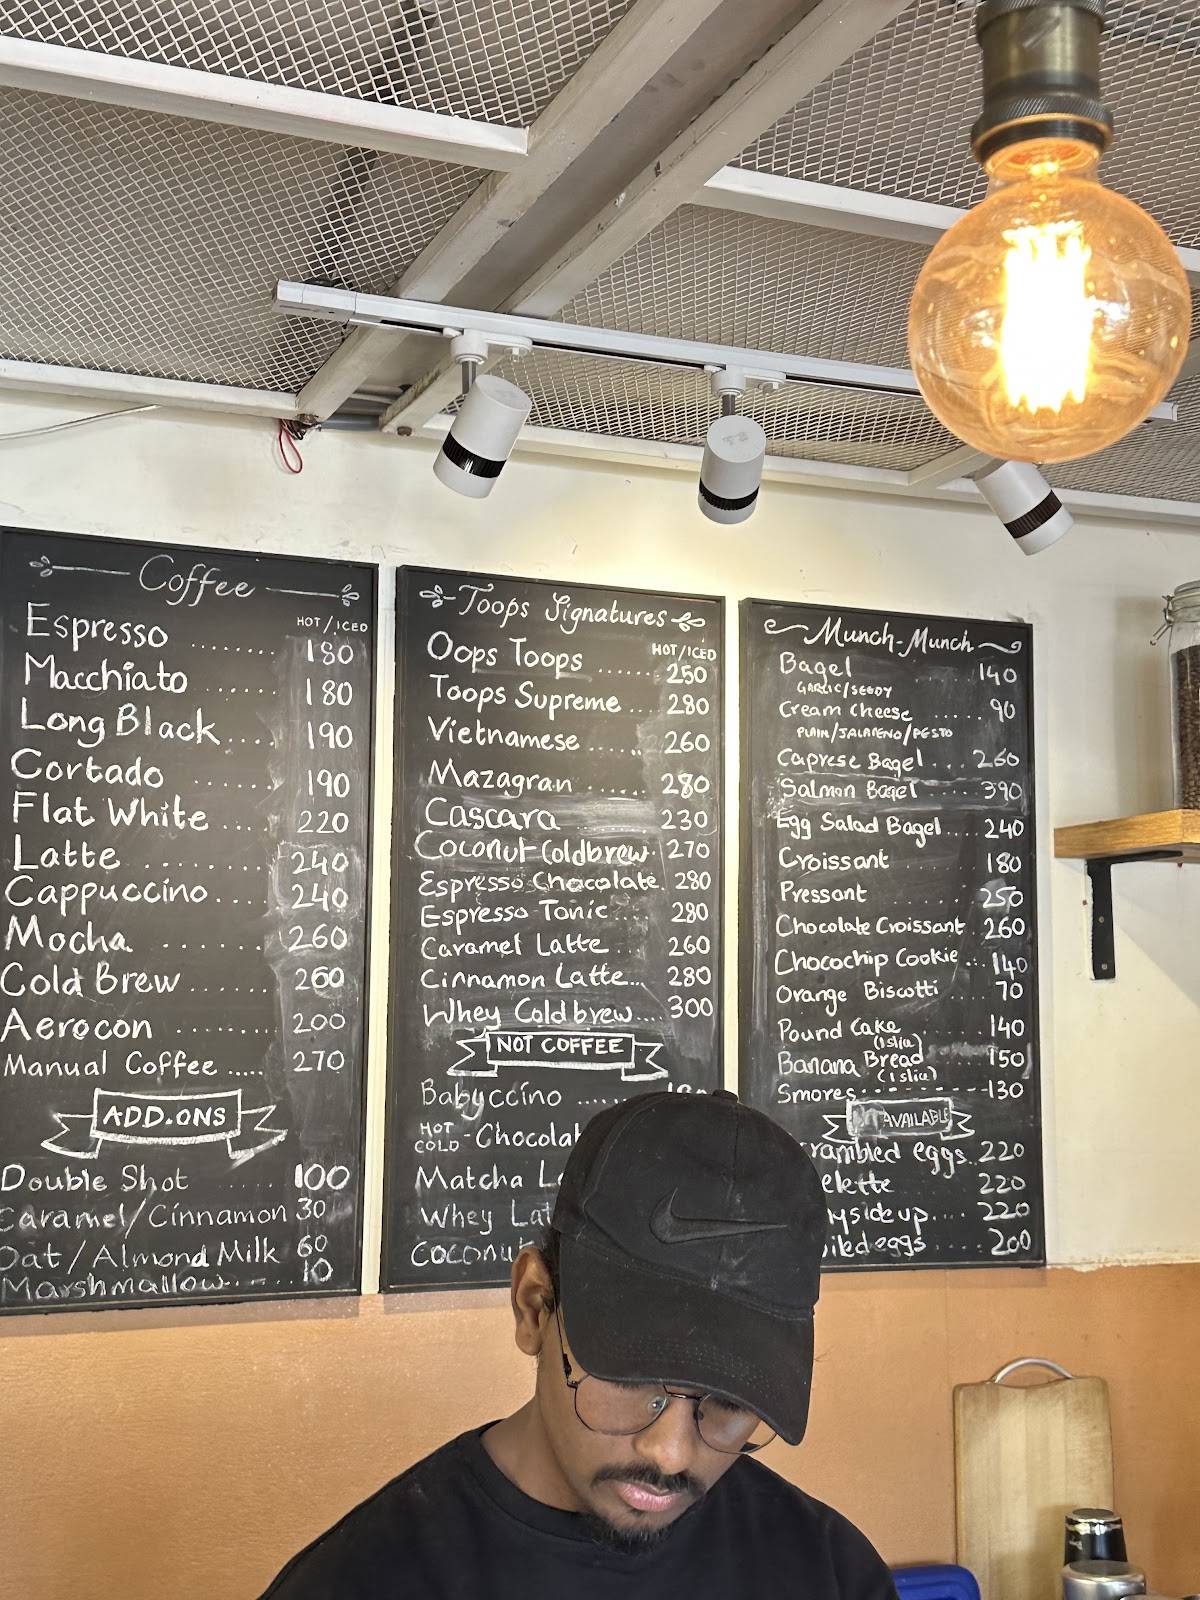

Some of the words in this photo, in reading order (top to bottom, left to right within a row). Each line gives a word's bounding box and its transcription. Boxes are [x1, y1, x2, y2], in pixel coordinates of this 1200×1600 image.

[139, 554, 256, 606] Coffee
[459, 584, 530, 628] Toops
[545, 592, 668, 634] Signatures
[27, 601, 169, 651] Espresso
[307, 639, 354, 665] 180
[427, 631, 498, 673] Oops
[509, 638, 583, 680] Toops
[666, 663, 707, 685] 250
[780, 652, 851, 687] Bagel
[979, 663, 1017, 685] 140
[24, 651, 188, 693] Macchiato
[306, 678, 353, 705] 180
[430, 674, 506, 712] Toops
[514, 681, 622, 720] Supreme
[666, 693, 709, 715] 280
[779, 701, 842, 718] Cream
[990, 699, 1016, 722] 90
[21, 697, 105, 748] Long
[116, 703, 221, 745] Black
[308, 721, 353, 750] 190
[427, 716, 580, 751] Vietnamese
[664, 731, 710, 754] 260
[10, 748, 164, 789] Cortado
[307, 770, 350, 798] 190
[428, 759, 572, 799] Mazagran
[661, 773, 710, 799] 280
[777, 748, 861, 774] Caprese
[868, 748, 923, 778] Bagel
[973, 749, 1019, 768] 260
[780, 778, 855, 799] Salmon
[867, 780, 917, 801] Bagel
[980, 781, 1022, 801] 390
[13, 791, 95, 826] Flat
[107, 794, 209, 831] White
[296, 811, 349, 834] 220
[425, 797, 560, 829] Cascara
[661, 810, 708, 829] 230
[776, 813, 811, 840] Egg
[820, 813, 879, 834] Salad
[886, 816, 942, 849] Bagel
[984, 818, 1024, 839] 240
[14, 834, 121, 870] Latte
[291, 851, 349, 874] 240
[667, 839, 710, 859] 270
[779, 847, 890, 871] Croissant
[988, 852, 1022, 873] 180
[4, 874, 208, 917] Cappuccino
[291, 884, 349, 912] 240
[418, 870, 524, 903] Espresso
[532, 871, 658, 892] Chocolate
[675, 871, 711, 891] 280
[980, 886, 1023, 908] 250
[4, 914, 133, 952] Mocha
[288, 925, 348, 952] 260
[420, 905, 528, 934] Espresso
[538, 900, 607, 921] Tonic
[671, 902, 708, 923] 280
[775, 914, 870, 938] Chocolate
[876, 915, 966, 935] Croissant
[984, 917, 1026, 940] 260
[421, 933, 522, 960] Caramel
[537, 933, 609, 956] Latte
[668, 936, 710, 956] 260
[0, 962, 84, 997] Cold
[95, 961, 181, 994] Brew
[295, 966, 345, 991] 260
[421, 969, 545, 990] Cinnamon
[555, 963, 628, 988] Latte
[667, 966, 711, 987] 280
[775, 949, 888, 977] Chocochip
[895, 947, 958, 967] Cookie
[992, 952, 1028, 980] 140
[423, 998, 501, 1031] Whey
[668, 995, 713, 1019] 300
[776, 985, 847, 1016] Orange
[864, 980, 939, 1000] Biscotti
[995, 981, 1023, 1001] 70
[0, 1007, 153, 1042] Aerocon
[293, 1013, 346, 1034] 200
[778, 1018, 842, 1042] Pound
[850, 1017, 901, 1036] Cake
[990, 1015, 1025, 1037] 140
[497, 1036, 533, 1054] NOT
[541, 1037, 624, 1055] COFFEE
[4, 1049, 107, 1078] Manual
[125, 1050, 218, 1078] Coffee
[293, 1050, 345, 1072] 270
[777, 1051, 861, 1078] Banana
[863, 1049, 924, 1068] Bread
[989, 1048, 1025, 1067] 150
[421, 1078, 562, 1120] Babyccino
[777, 1084, 856, 1103] Smores
[988, 1080, 1024, 1099] 130
[420, 1121, 454, 1137] HOT
[882, 1108, 949, 1129] AVAILABLE
[414, 1140, 460, 1153] COLD
[799, 1141, 901, 1164] rambled
[913, 1141, 967, 1179] eggs
[979, 1141, 1025, 1163] 220
[1, 1164, 107, 1192] Double
[121, 1164, 189, 1192] Shot
[295, 1163, 350, 1190] 100
[415, 1165, 523, 1191] Matcha
[979, 1172, 1026, 1194] 220
[296, 1198, 326, 1220] 30
[420, 1202, 492, 1235] Whey
[977, 1201, 1030, 1221] 220
[0, 1242, 62, 1271] Oat
[92, 1243, 209, 1269] Almond
[217, 1236, 280, 1266] Milk
[297, 1234, 328, 1257] 60
[988, 1228, 1031, 1255] 200
[2, 1272, 223, 1300] Marshmallow
[304, 1258, 333, 1283] 10
